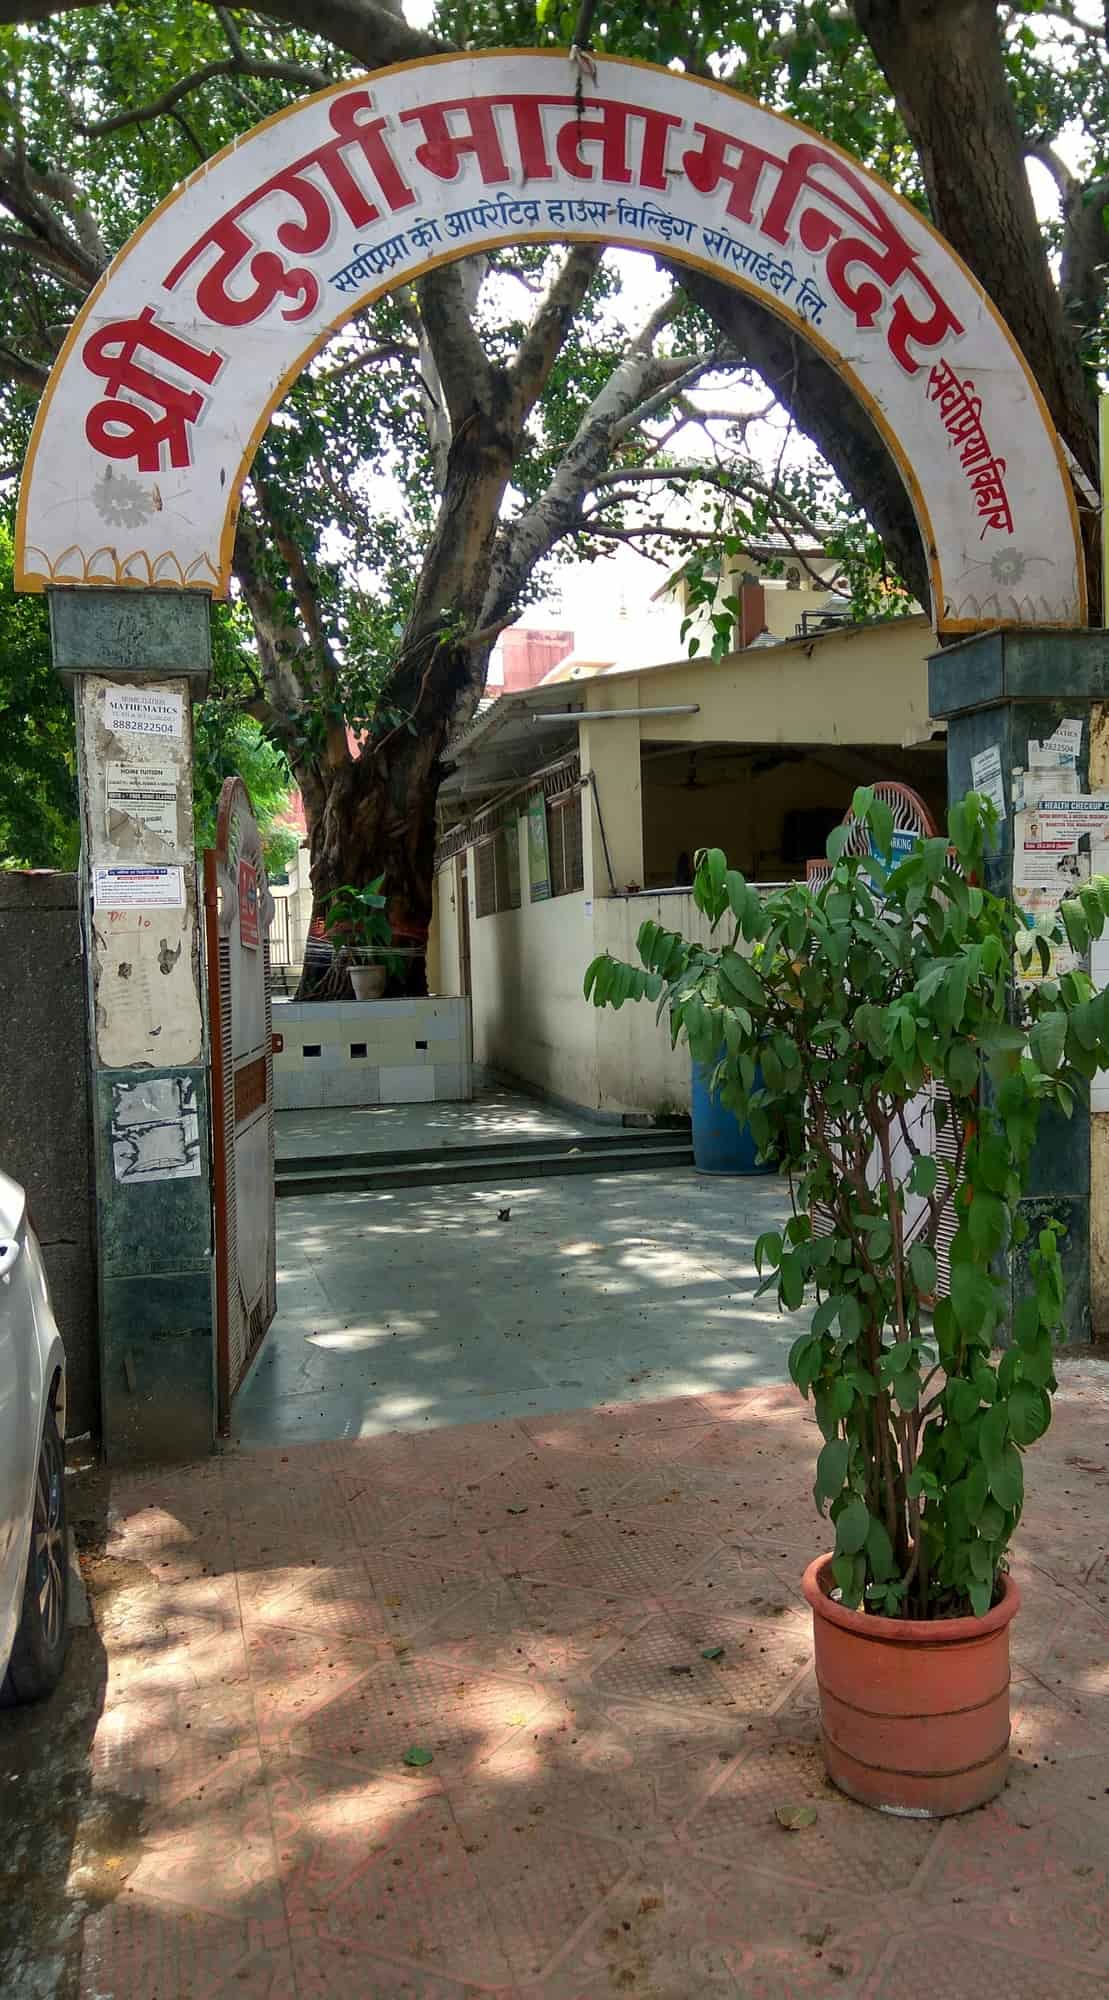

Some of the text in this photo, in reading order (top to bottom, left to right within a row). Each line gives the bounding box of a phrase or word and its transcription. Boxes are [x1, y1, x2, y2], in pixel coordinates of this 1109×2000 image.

[82, 90, 966, 472] श्री दुर्गा माता मन्दिर
[110, 701, 178, 714] MATHEMATICS
[111, 719, 174, 734] 8882822504
[1044, 802, 1070, 811] HEALTH
[1071, 802, 1102, 811] CHECKUP
[890, 837, 912, 850] RKING
